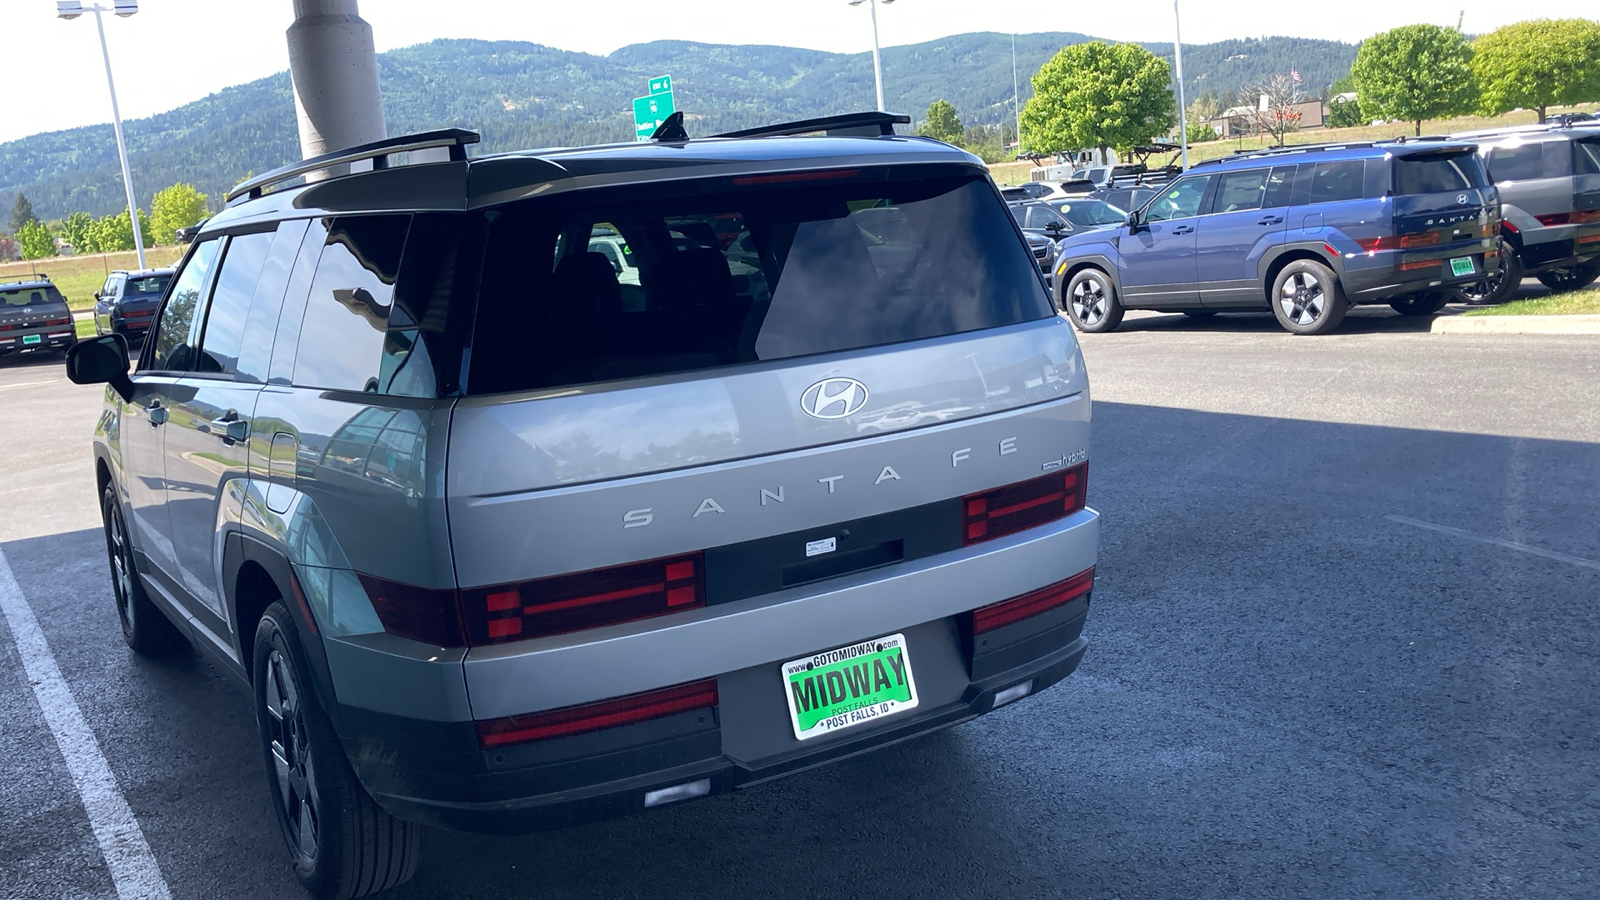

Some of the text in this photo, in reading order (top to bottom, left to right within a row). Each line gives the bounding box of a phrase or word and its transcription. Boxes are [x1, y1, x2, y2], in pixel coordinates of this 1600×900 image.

[663, 79, 668, 89] 6
[1427, 214, 1474, 225] SANTA
[1062, 447, 1086, 467] hybrid
[622, 436, 1018, 529] SANTA FE
[791, 652, 905, 714] MIDWAY
[826, 703, 889, 729] POST FALLS, ID
[831, 697, 878, 716] POST FALLS
